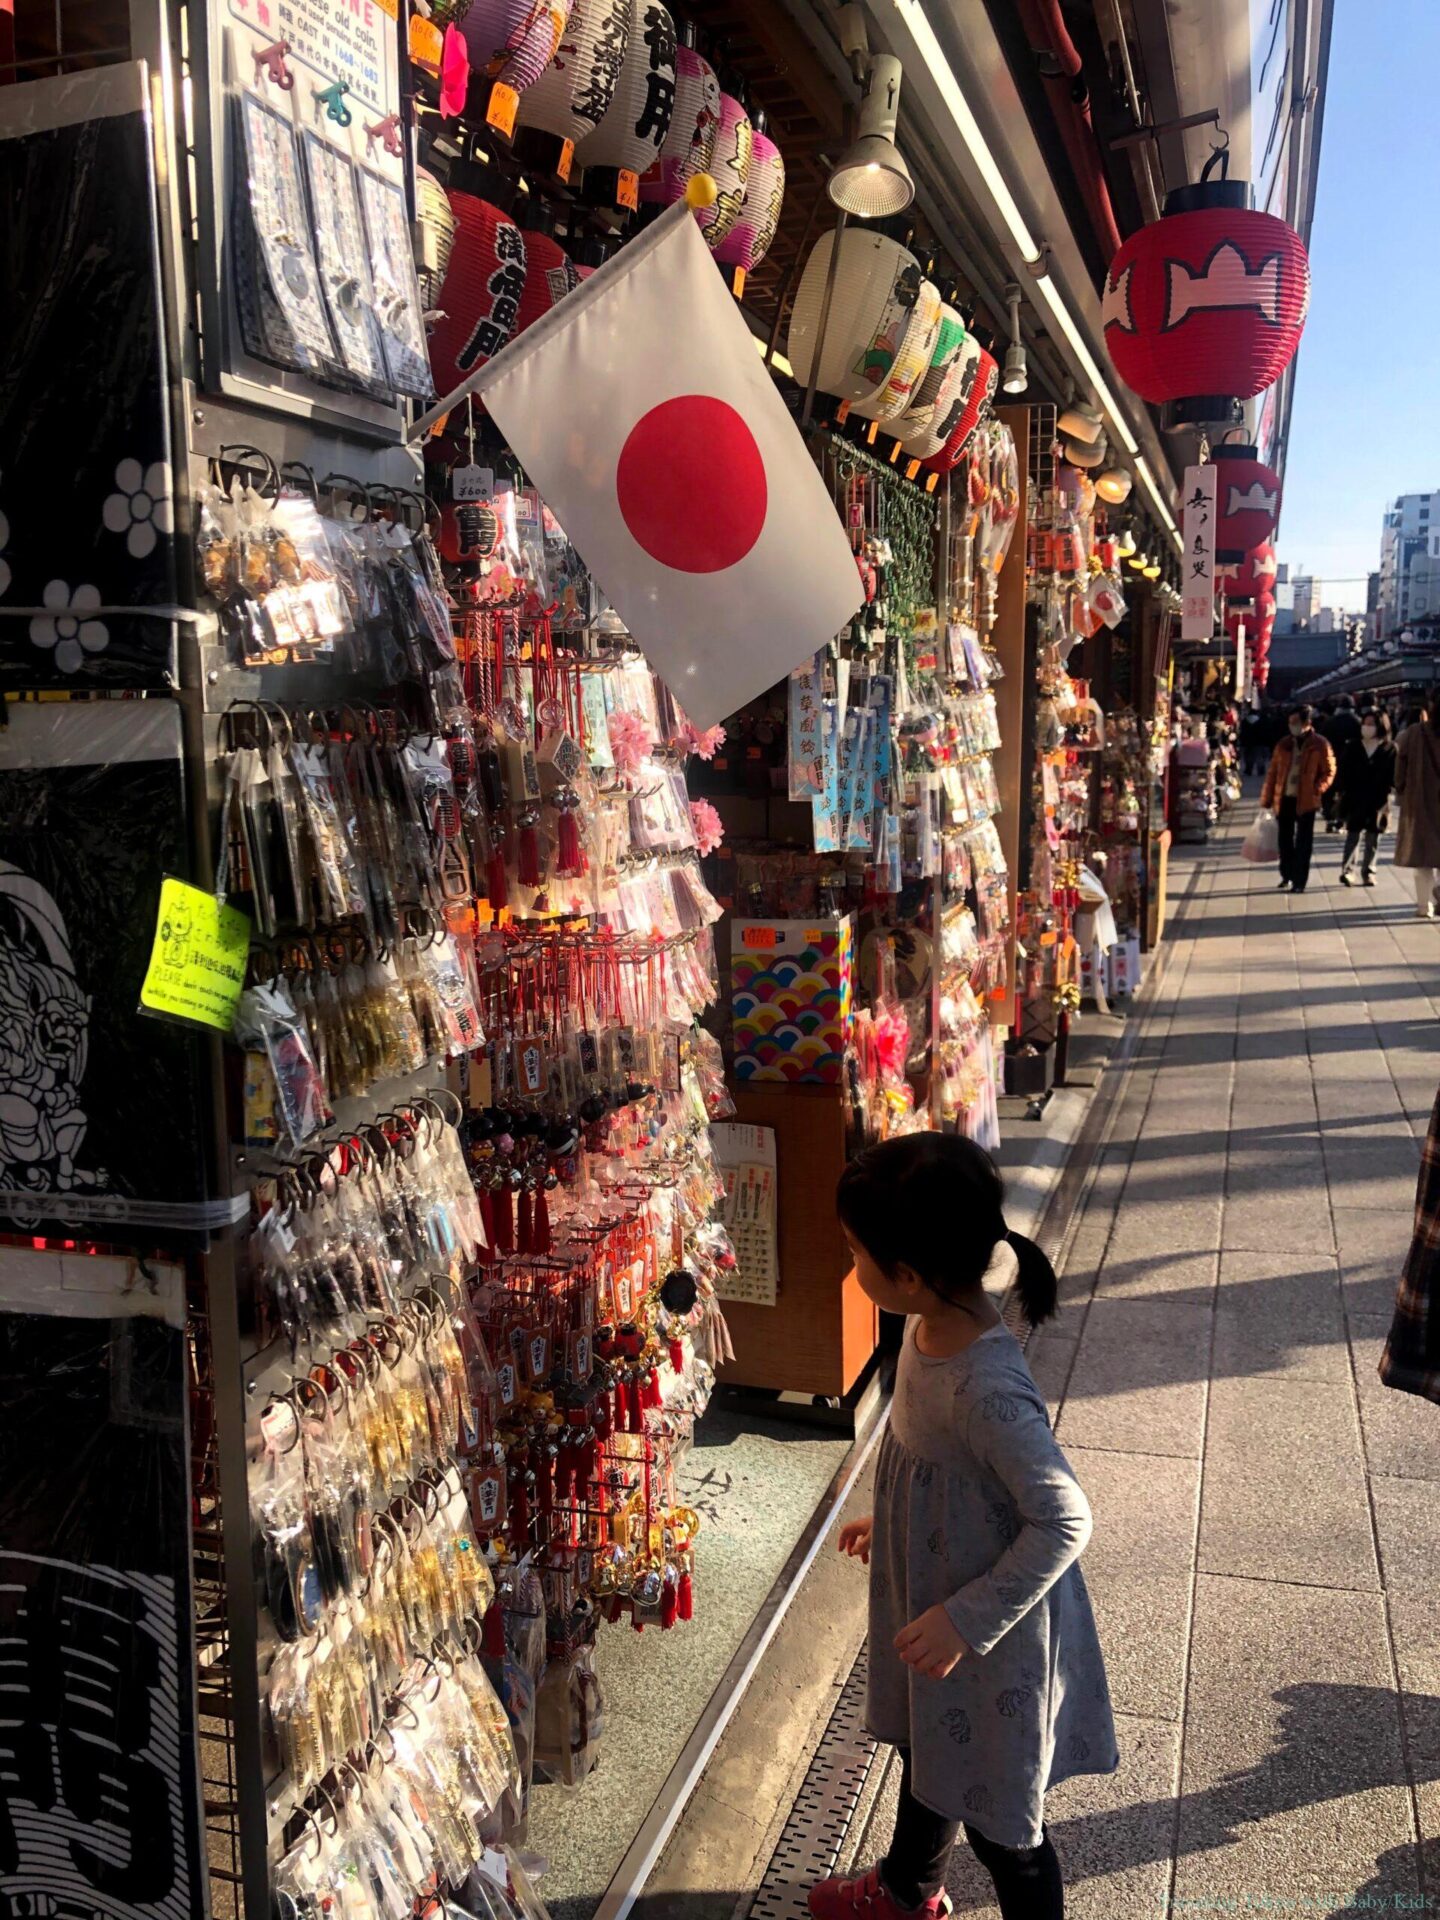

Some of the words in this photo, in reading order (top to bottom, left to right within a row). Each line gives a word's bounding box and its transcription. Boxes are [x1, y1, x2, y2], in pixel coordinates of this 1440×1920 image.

[335, 10, 350, 30] old
[341, 0, 373, 28] NE
[298, 16, 319, 40] CAST
[323, 33, 330, 49] IN
